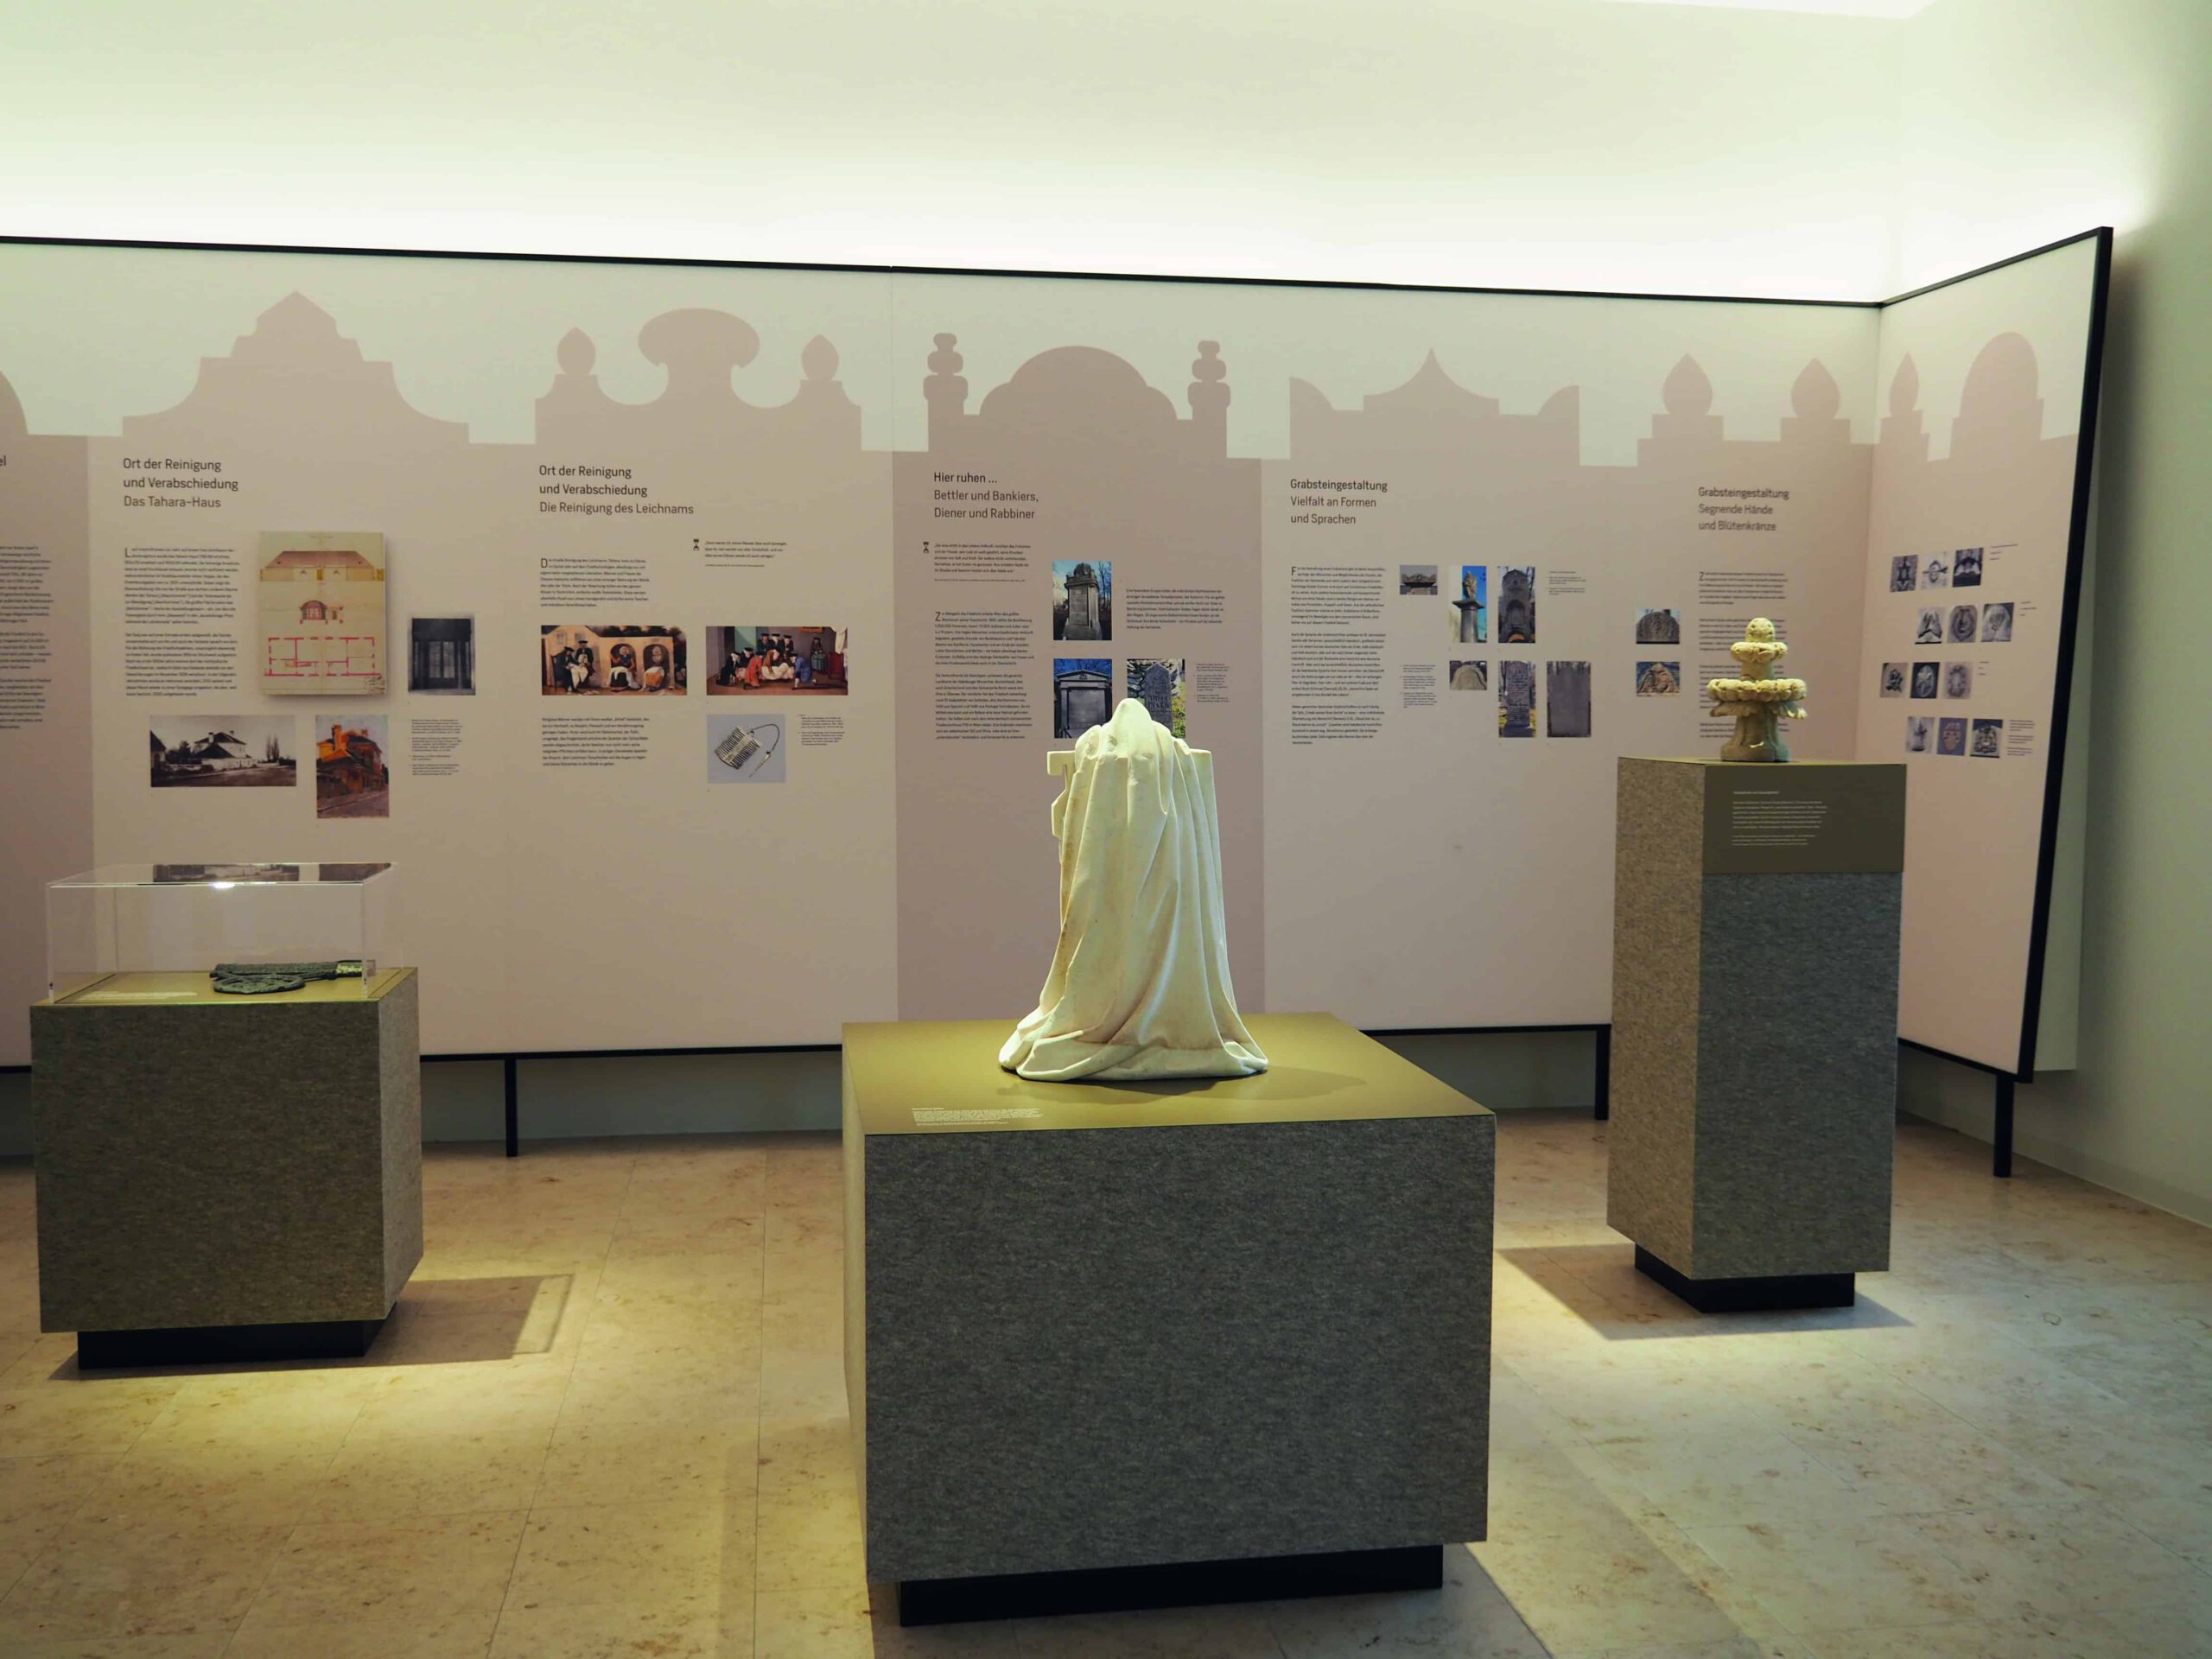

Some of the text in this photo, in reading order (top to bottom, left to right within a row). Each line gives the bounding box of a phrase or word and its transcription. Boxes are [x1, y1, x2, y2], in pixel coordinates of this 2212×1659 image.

[123, 458, 221, 473] Ort der Reinigung
[539, 465, 632, 480] Ort der Reinigung
[934, 472, 954, 483] Hier
[957, 473, 986, 483] ruhen
[123, 477, 238, 492] und Verabschiedung
[539, 483, 648, 498] und Verabschiedung
[1290, 479, 1388, 493] Grabsteingestaltung
[934, 489, 1039, 502] Bettler und Bankiers,
[1699, 486, 1789, 500] Grabsteingestaltung
[124, 495, 221, 508] Das Tahara-Haus
[1290, 496, 1376, 508] Vielfalt an Formen
[540, 501, 694, 516] Die Reinigung des Leichnams
[934, 507, 1035, 519] Diener und Rabbiner
[1699, 504, 1773, 516] Segnende Hände
[1290, 513, 1356, 525] und Sprachen
[1699, 520, 1777, 531] und Blütenkränze
